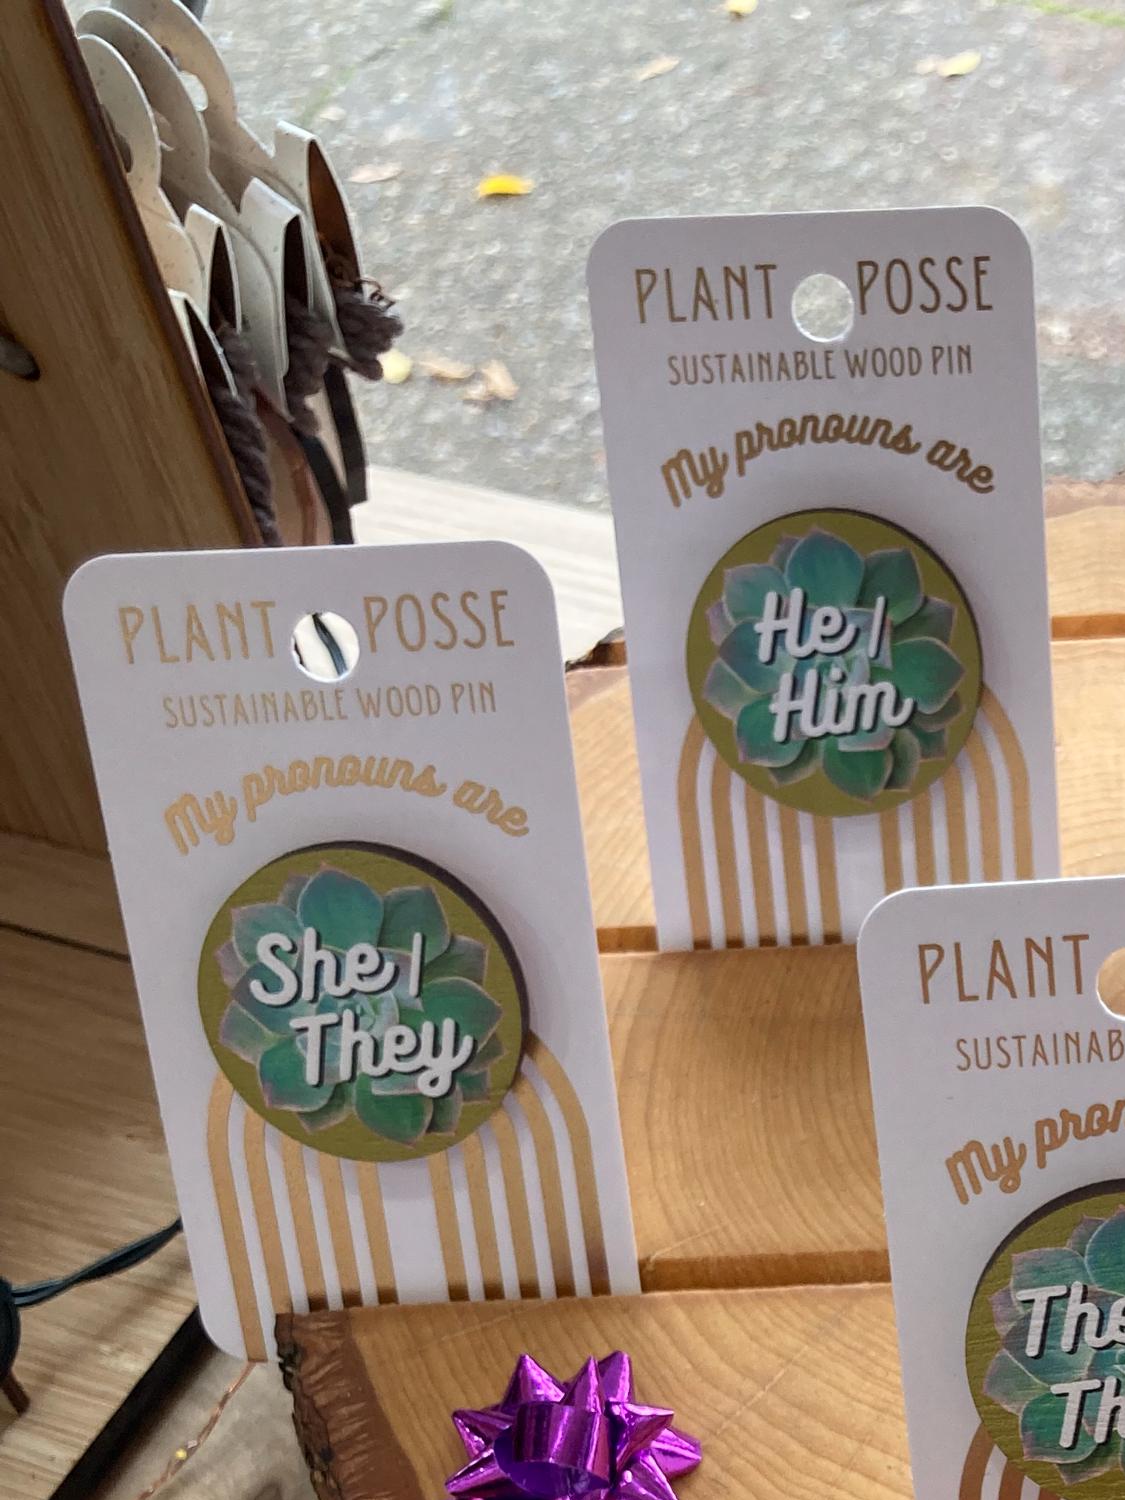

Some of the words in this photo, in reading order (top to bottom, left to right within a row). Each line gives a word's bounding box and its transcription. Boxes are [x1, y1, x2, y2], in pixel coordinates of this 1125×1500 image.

[635, 263, 777, 323] PLANT
[857, 255, 993, 315] POSSE
[667, 348, 835, 386] SUSTAINABLE
[844, 347, 921, 380] WOOD
[932, 344, 972, 375] PIN
[661, 445, 727, 507] My
[734, 412, 921, 476] pronouns
[927, 439, 994, 494] are
[118, 601, 276, 666] PLANT
[363, 589, 515, 653] POSSE
[162, 686, 349, 729] SUSTAINABLE
[359, 687, 443, 719] WOOD
[451, 681, 497, 714] PIN
[769, 667, 915, 743] Him
[163, 789, 239, 855] My
[242, 754, 446, 811] pronouns
[454, 781, 529, 838] are
[917, 934, 1090, 1004] PLANT
[290, 1015, 473, 1098] They
[946, 1136, 1027, 1206] My
